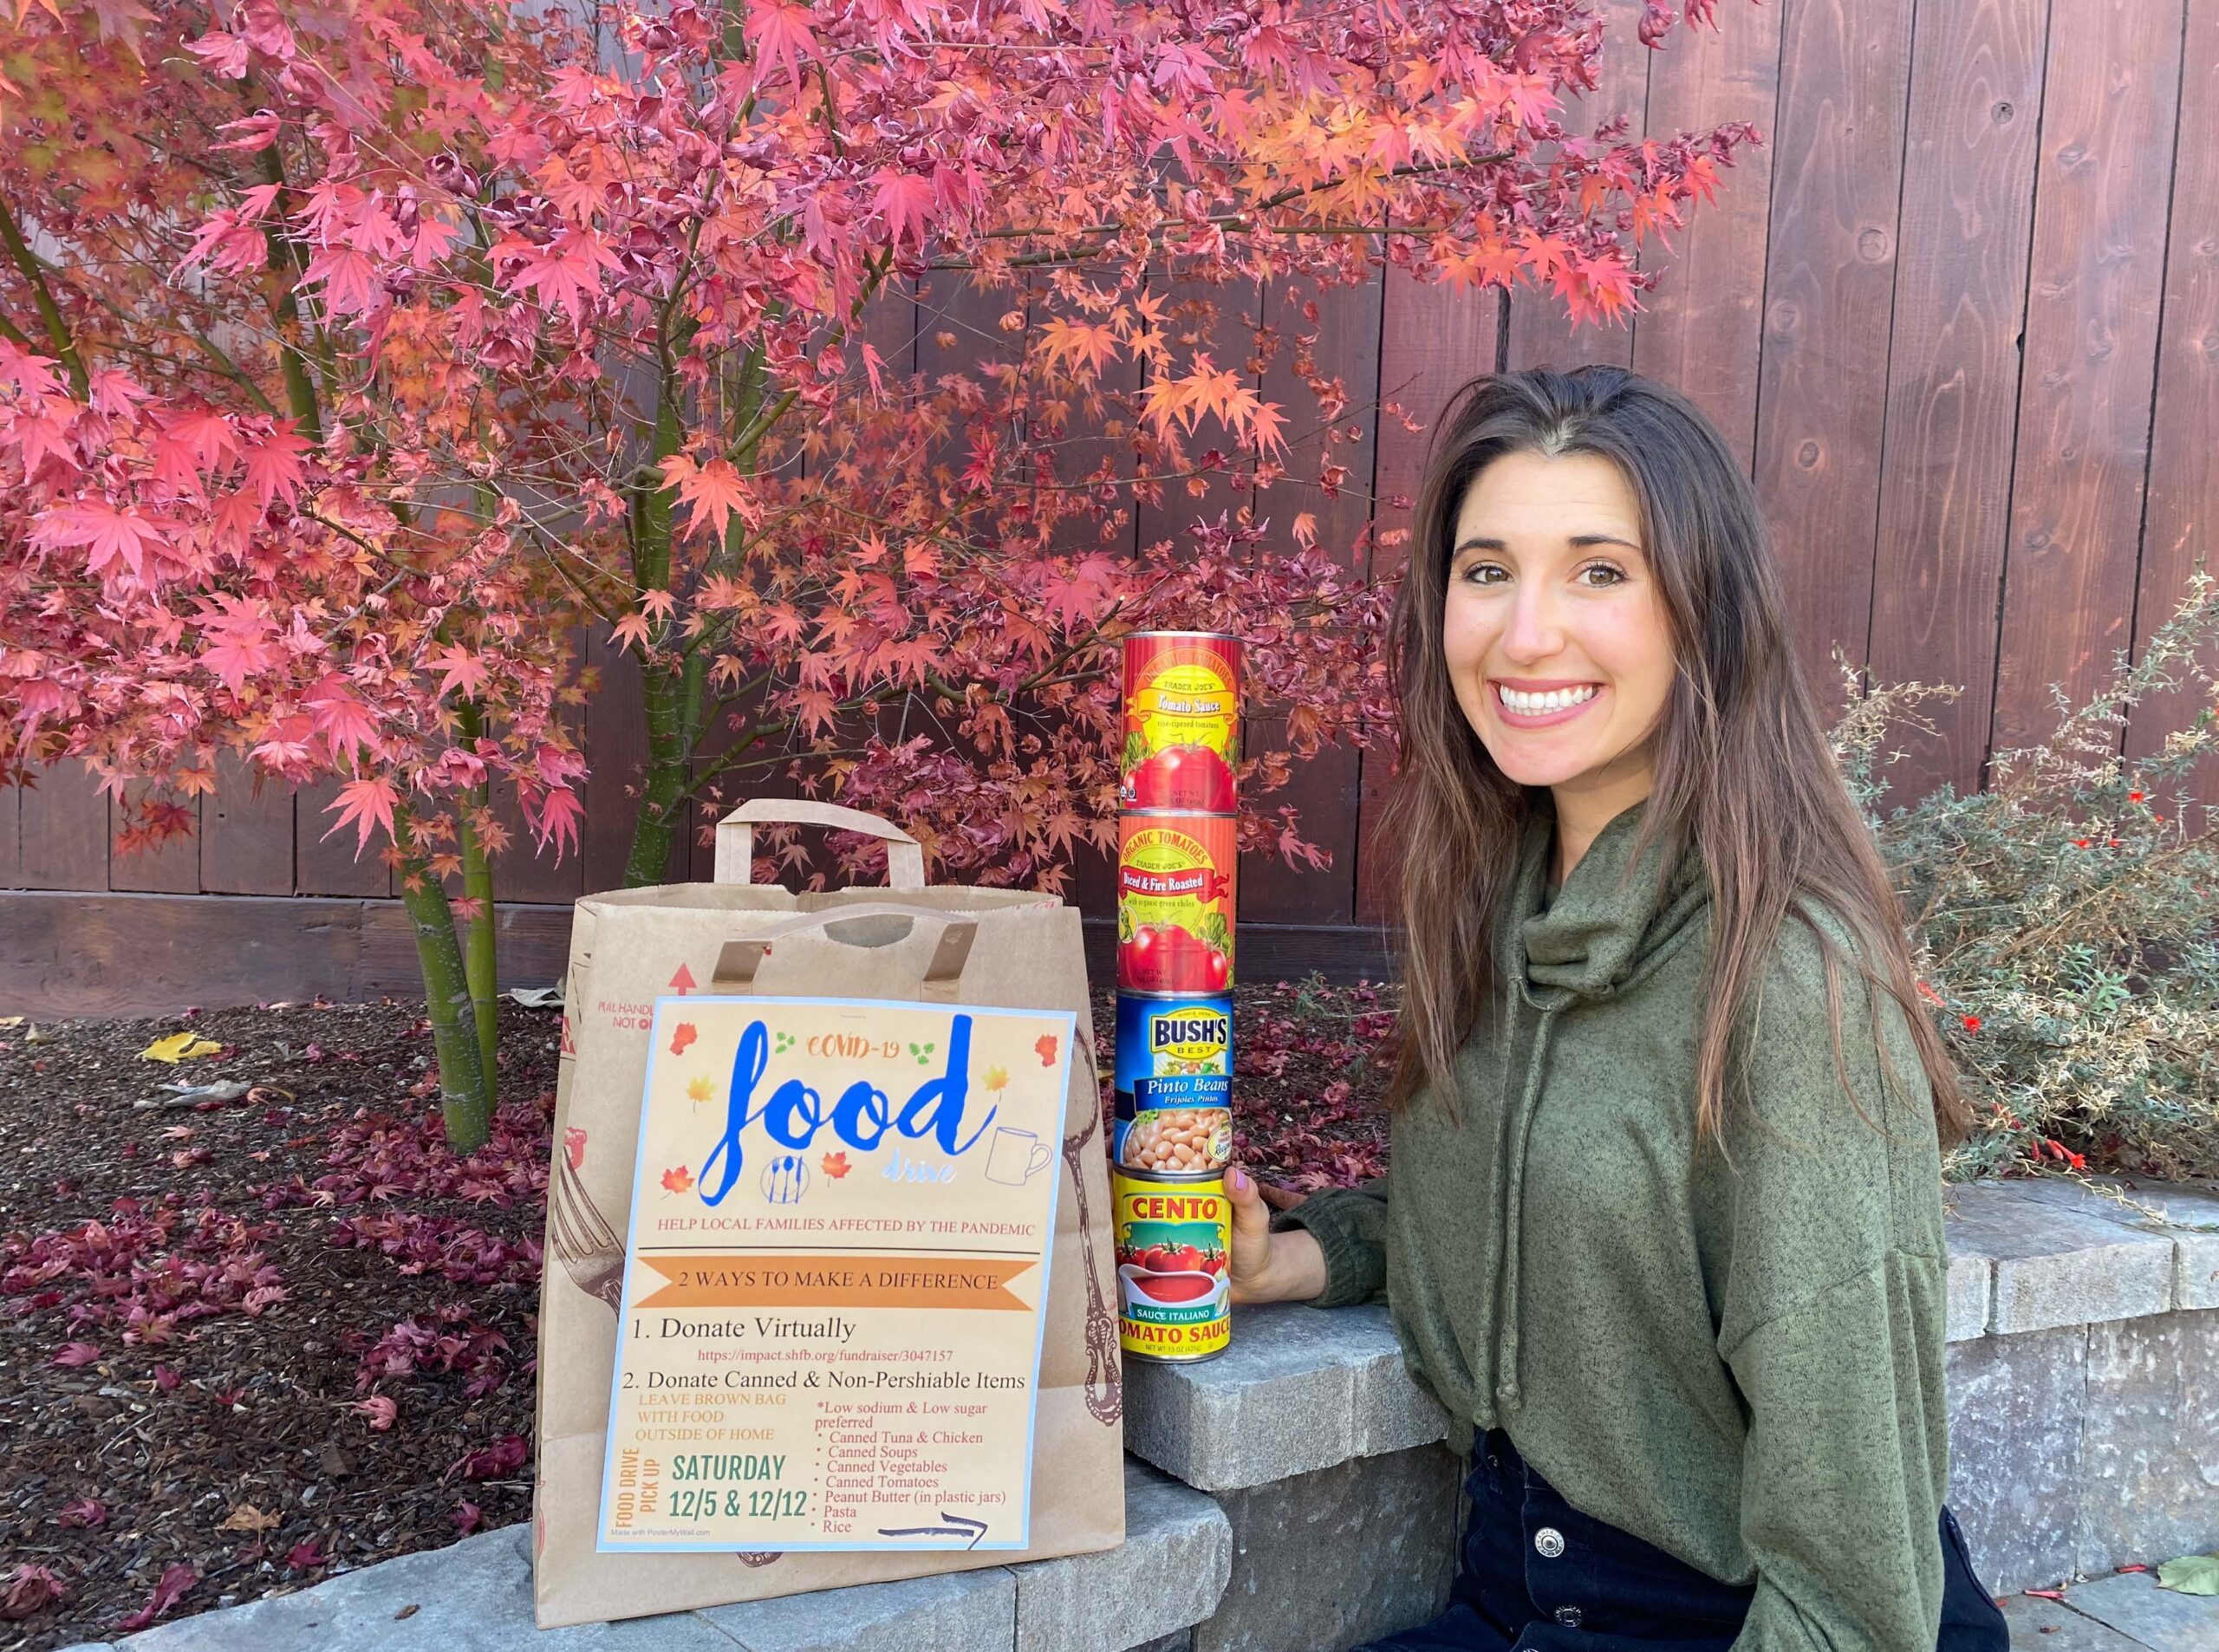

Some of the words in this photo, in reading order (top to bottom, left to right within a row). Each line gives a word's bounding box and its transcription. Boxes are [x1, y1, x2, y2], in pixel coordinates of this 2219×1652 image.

[1164, 681, 1192, 691] TRADER
[1194, 682, 1214, 691] JOE'S
[1158, 694, 1192, 712] Tomato
[1194, 698, 1220, 713] Sauce
[1195, 720, 1219, 729] tomatoes
[1123, 831, 1154, 862] ORGANIC
[1158, 831, 1208, 865] TOMATOES
[1136, 860, 1161, 870] TRADER
[1162, 861, 1183, 870] JOE'S
[1123, 872, 1140, 888] Diced
[1141, 877, 1149, 890] &
[1150, 878, 1167, 891] Fire
[1168, 873, 1203, 891] Roasted
[1138, 899, 1158, 907] organic
[1177, 899, 1194, 907] chiles
[618, 1003, 654, 1016] HANDL
[613, 1017, 635, 1030] NOT
[1155, 1018, 1227, 1047] BUSH'S
[807, 1031, 900, 1059] COVID-19
[1148, 1078, 1188, 1095] Pinto
[1194, 1078, 1228, 1092] Beans
[1164, 1096, 1194, 1105] Frijoles
[698, 1014, 997, 1206] food
[882, 1148, 957, 1183] drive
[1132, 1197, 1218, 1219] CENTO
[658, 1219, 698, 1231] HELP
[701, 1219, 752, 1231] LOCAL
[757, 1219, 824, 1231] FAMILIES
[829, 1219, 902, 1232] AFFECTED
[907, 1220, 926, 1232] BY
[930, 1221, 957, 1233] THE
[961, 1222, 1035, 1237] PANDEMIC
[679, 1272, 688, 1287] 2
[696, 1272, 756, 1287] WAYS
[762, 1271, 788, 1287] TO
[794, 1272, 853, 1287] MAKE
[859, 1272, 872, 1287] A
[879, 1272, 998, 1290] DIFFERENCE
[1136, 1309, 1167, 1322] SAUCE
[1168, 1310, 1210, 1321] ITALIANO
[633, 1318, 650, 1339] 1.
[660, 1317, 745, 1338] Donate
[754, 1317, 856, 1343] Virtually
[1118, 1318, 1182, 1343] OMATO
[698, 1349, 953, 1363] https://impact.shfb.org/fundraiser/3047157
[622, 1372, 639, 1389] 2.
[648, 1371, 718, 1388] Donate
[725, 1370, 797, 1388] Canned
[804, 1370, 820, 1388] &
[828, 1371, 970, 1389] Non-Pershiable
[977, 1372, 1025, 1389] Items
[639, 1394, 690, 1405] LEAVE
[694, 1394, 751, 1405] BROWN
[755, 1394, 786, 1405] BAG
[638, 1411, 677, 1422] WITH
[682, 1411, 724, 1422] FOOD
[857, 1402, 902, 1414] sodium
[907, 1402, 918, 1414] &
[922, 1402, 950, 1414] Low
[954, 1404, 988, 1417] sugar
[815, 1416, 873, 1431] preferred
[635, 1429, 701, 1441] OUTSIDE
[706, 1429, 725, 1441] OF
[730, 1429, 774, 1440] HOME
[830, 1432, 877, 1444] Canned
[882, 1432, 913, 1444] Tuna
[916, 1432, 928, 1444] &
[932, 1432, 983, 1444] Chicken
[829, 1446, 876, 1458] Canned
[880, 1446, 918, 1461] Soups
[620, 1447, 640, 1487] DRIVE
[643, 1459, 660, 1477] UP
[672, 1454, 786, 1480] SATURDAY
[827, 1460, 875, 1473] Canned
[879, 1460, 947, 1475] Vegetables
[825, 1475, 874, 1488] Canned
[878, 1475, 939, 1488] Tomatoes
[640, 1481, 659, 1512] PICK
[824, 1490, 867, 1503] Peanut
[871, 1490, 910, 1503] Butter
[914, 1491, 931, 1505] (in
[934, 1491, 973, 1506] plastic
[977, 1491, 1006, 1506] jars)
[615, 1492, 635, 1528] FOOD
[669, 1488, 718, 1521] 12/5
[724, 1489, 740, 1517] &
[748, 1488, 808, 1521] 12/12
[823, 1506, 856, 1518] Pasta
[647, 1529, 711, 1538] PosterMyWall.com
[823, 1520, 852, 1532] Rice
